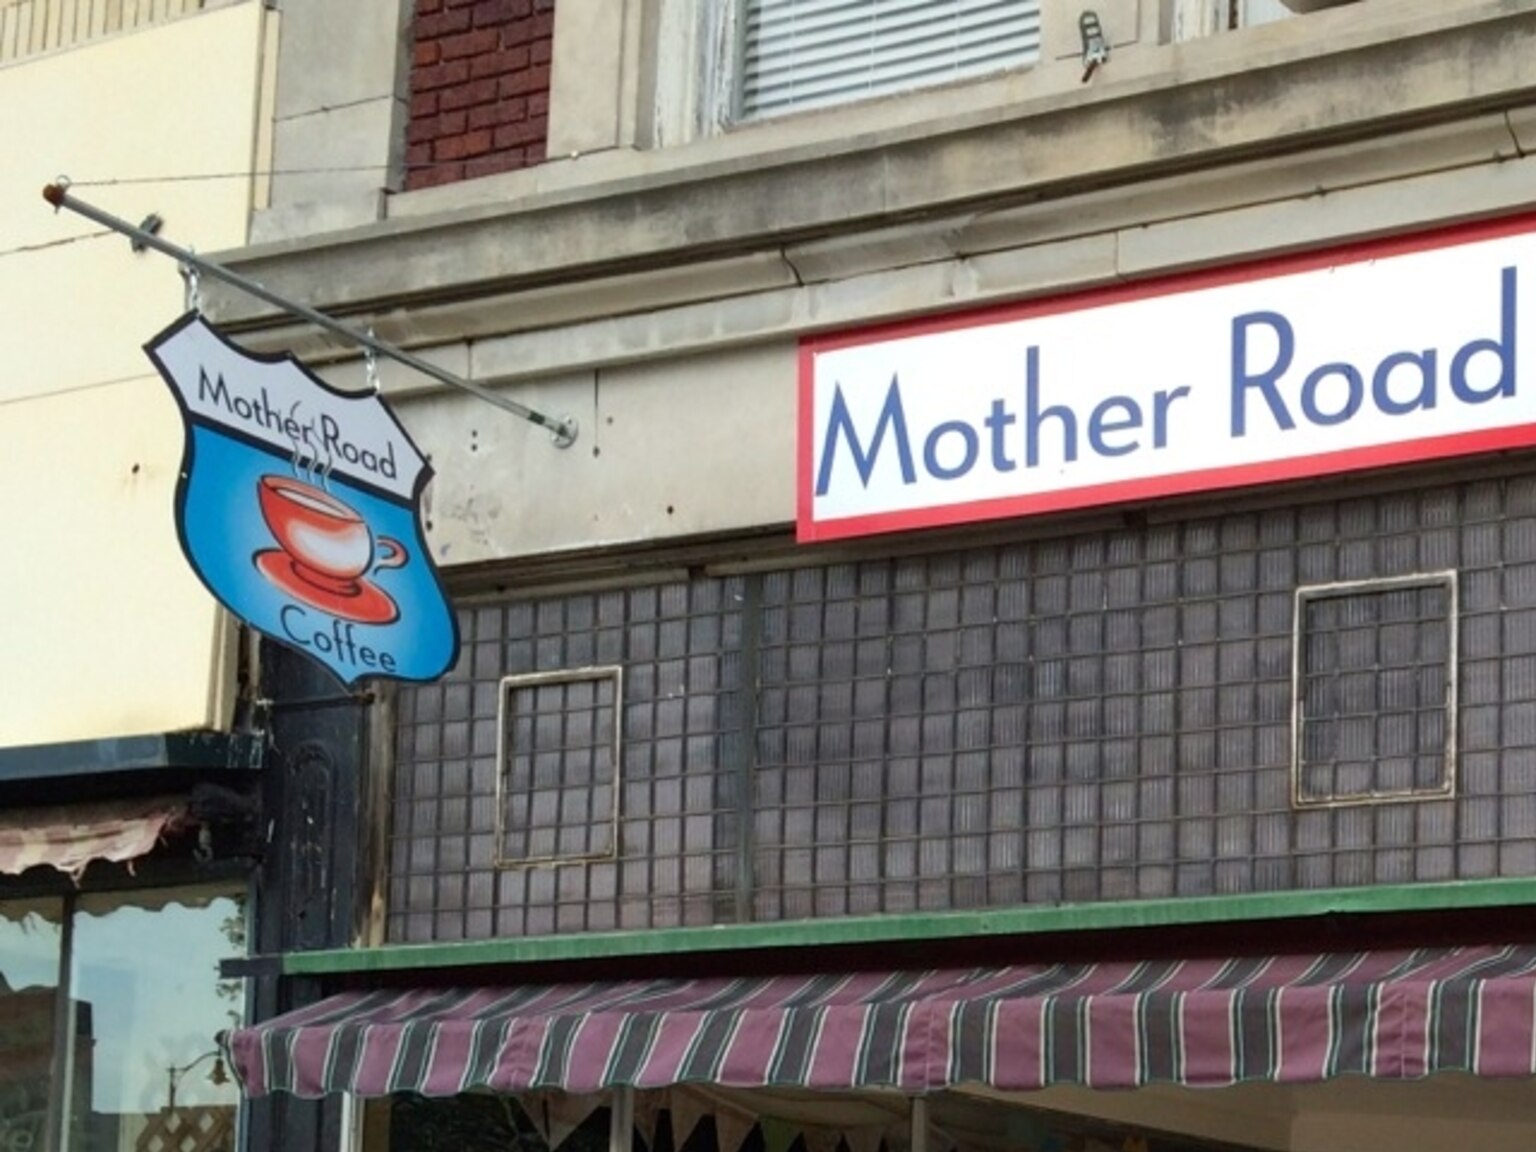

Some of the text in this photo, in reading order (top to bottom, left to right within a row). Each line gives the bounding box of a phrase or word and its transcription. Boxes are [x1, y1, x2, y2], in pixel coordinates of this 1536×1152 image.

[199, 365, 398, 480] Mother Road
[816, 346, 1191, 496] Mother
[1230, 266, 1517, 437] Road
[280, 604, 398, 672] Coffee
